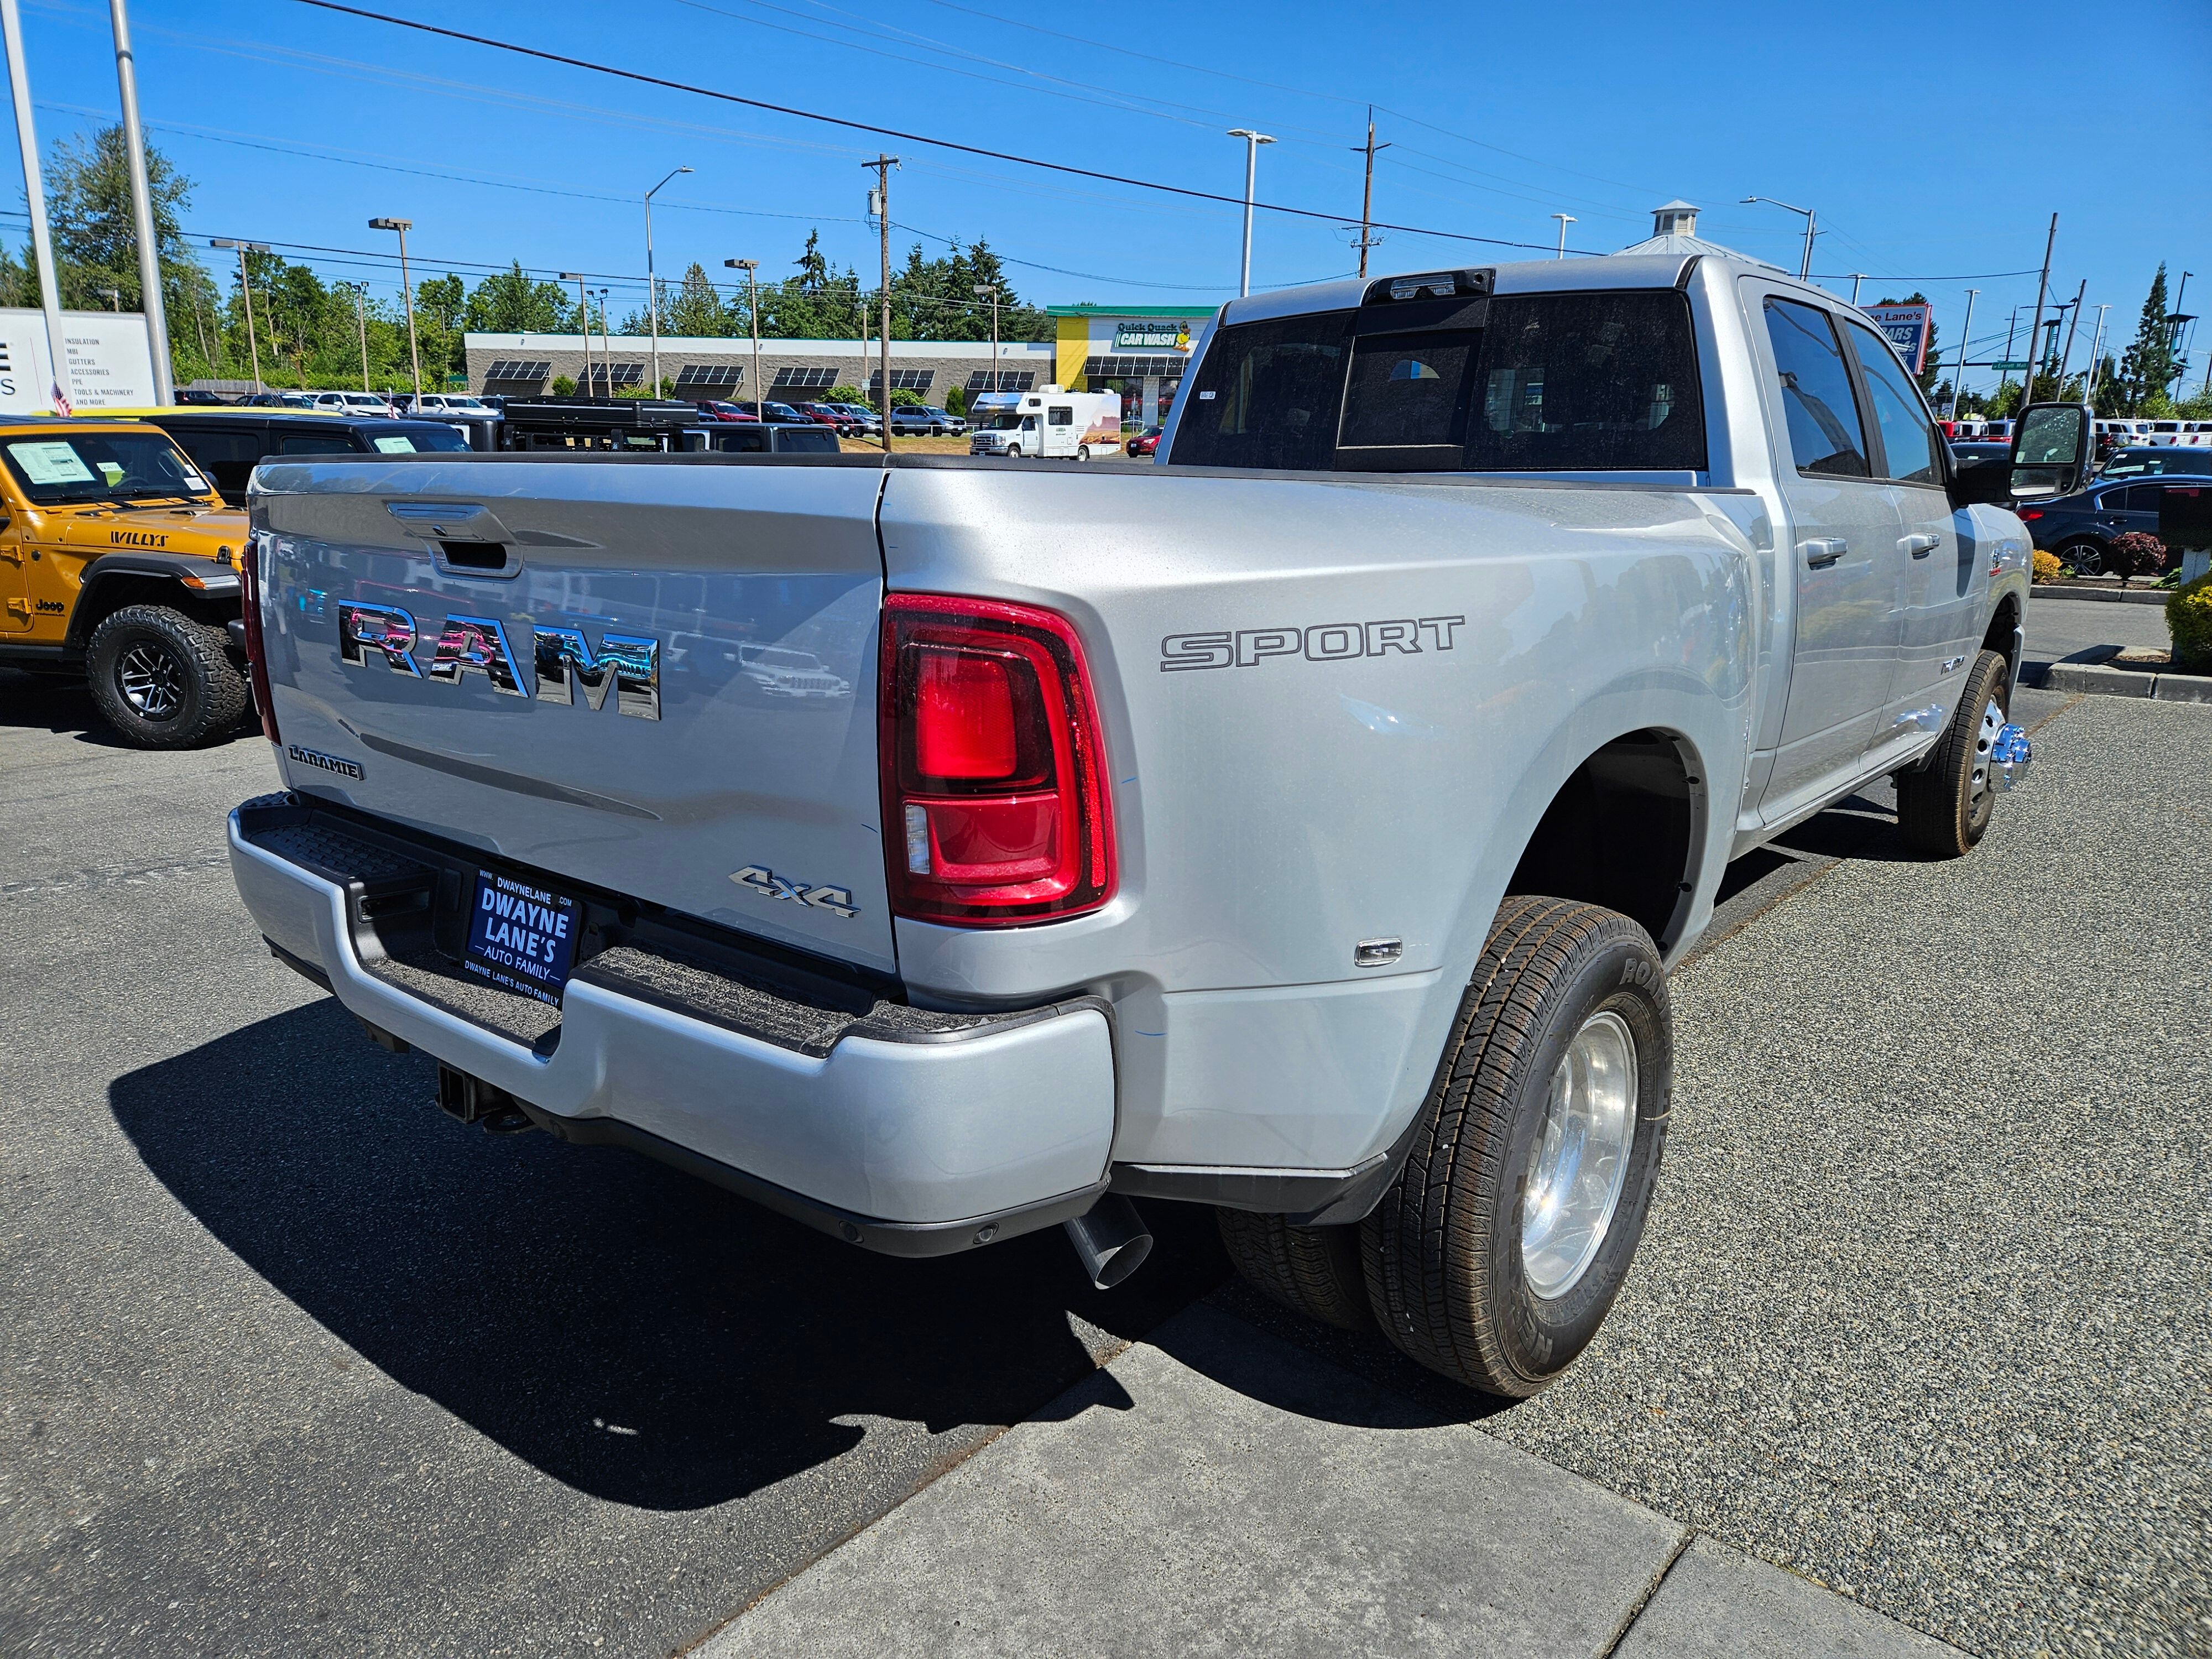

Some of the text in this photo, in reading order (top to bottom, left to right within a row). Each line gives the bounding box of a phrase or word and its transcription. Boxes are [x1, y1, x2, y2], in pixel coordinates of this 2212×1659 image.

[1118, 322, 1178, 332] Quick Quack
[1885, 312, 1922, 321] Lane's
[1120, 333, 1176, 346] CAR WASH
[111, 531, 169, 547] WILLYS
[35, 598, 65, 613] Jeep
[338, 598, 661, 721] RAM
[1160, 615, 1465, 672] SPORT
[288, 744, 365, 780] LARAMIE
[497, 877, 551, 904] DWAYNELANE
[481, 888, 568, 938] DWAYNE
[485, 917, 556, 963] LANE'S
[484, 946, 551, 980] AUTO FAMILY
[465, 960, 559, 1007] DWAYNE LANE'S AUTO FAMILY
